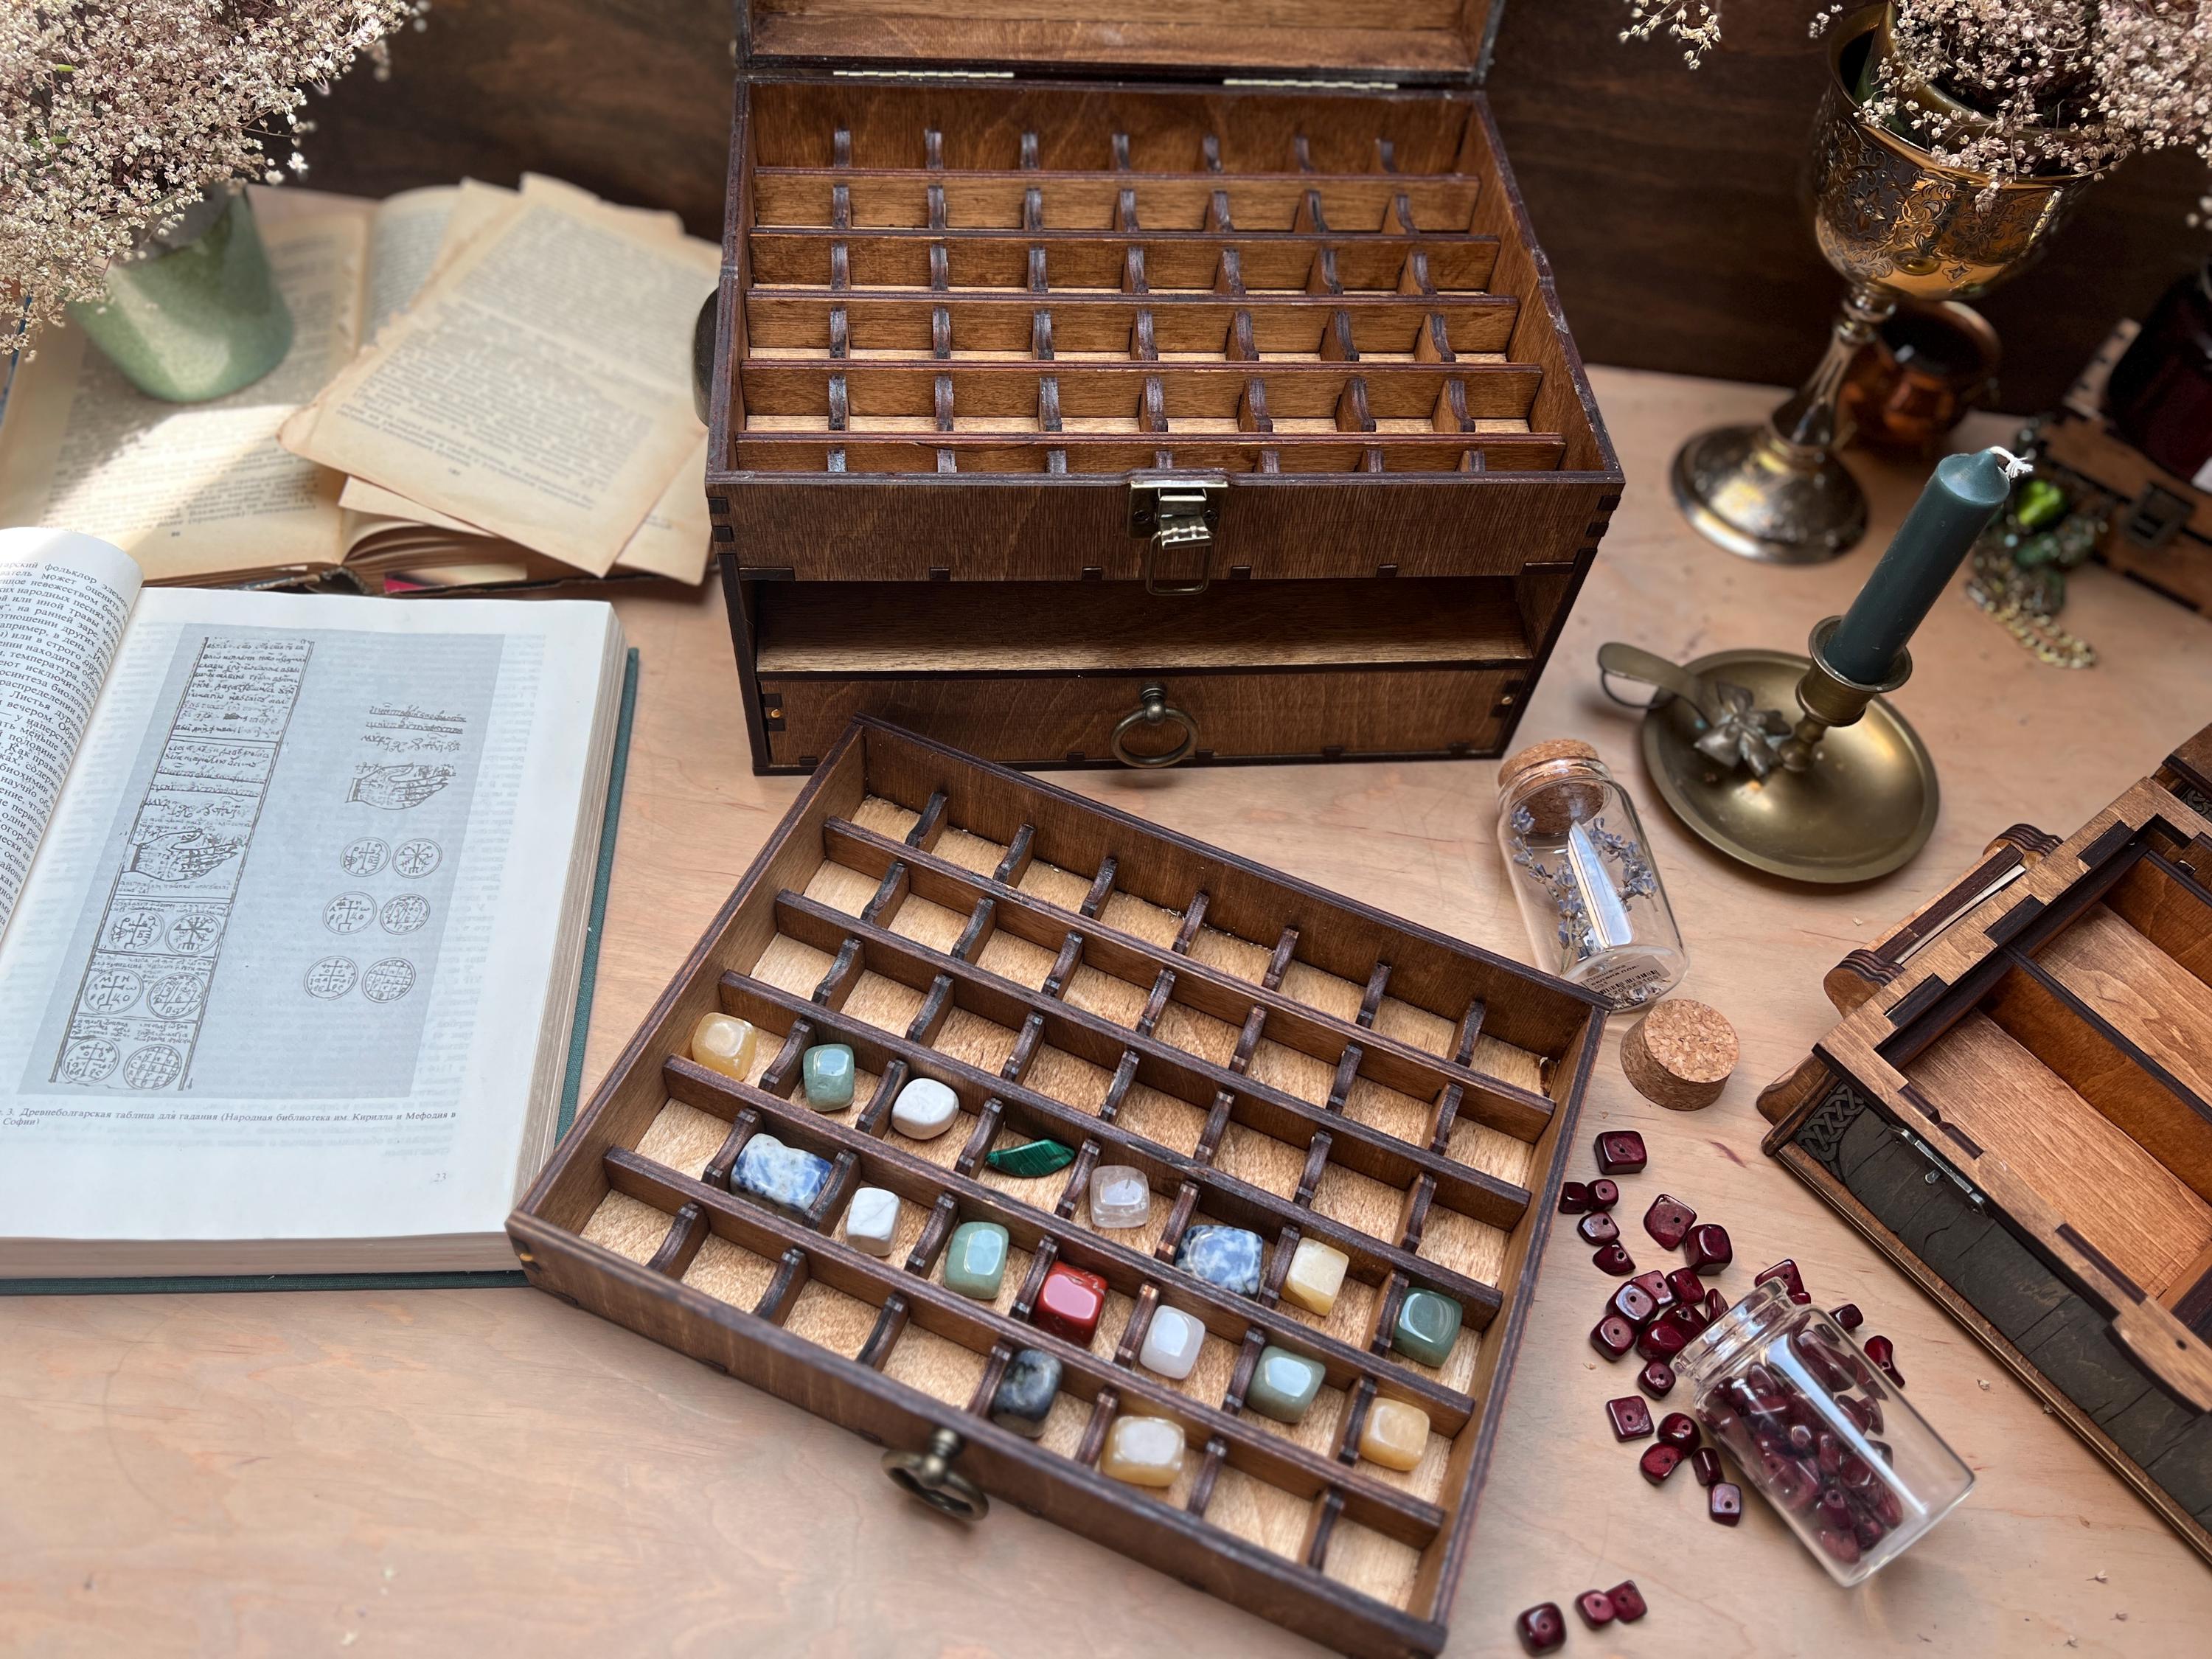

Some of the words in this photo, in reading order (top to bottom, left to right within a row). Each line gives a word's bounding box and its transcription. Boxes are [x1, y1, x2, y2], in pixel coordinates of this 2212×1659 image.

[44, 563, 97, 585] фольклор
[30, 580, 98, 605] невежеством
[41, 573, 77, 585] может
[85, 585, 119, 612] оценить
[17, 588, 70, 603] народных
[73, 599, 105, 621] песнях
[34, 608, 74, 624] ранней
[36, 599, 65, 611] иной
[69, 608, 100, 627] травы
[11, 633, 32, 641] или
[46, 641, 82, 661] строго
[60, 626, 96, 647] других
[62, 637, 86, 652] день
[26, 644, 80, 671] находится
[9, 690, 51, 710] Листья
[7, 701, 54, 725] вечером.
[8, 734, 57, 762] половине
[9, 742, 30, 758] Как
[20, 726, 59, 751] меньше
[0, 762, 49, 795] биохимии
[1, 776, 37, 798] научно
[1, 812, 27, 830] одни
[11, 804, 44, 834] периоды
[28, 801, 48, 824] чтобы
[2, 1118, 40, 1127] Софии)
[19, 1107, 111, 1119] Древнеболгарская
[115, 1112, 155, 1120] таблица
[179, 1113, 218, 1121] гадания
[220, 1113, 273, 1122] (Народная
[352, 1113, 393, 1122] Кирилла
[406, 1112, 448, 1121] Мефодия
